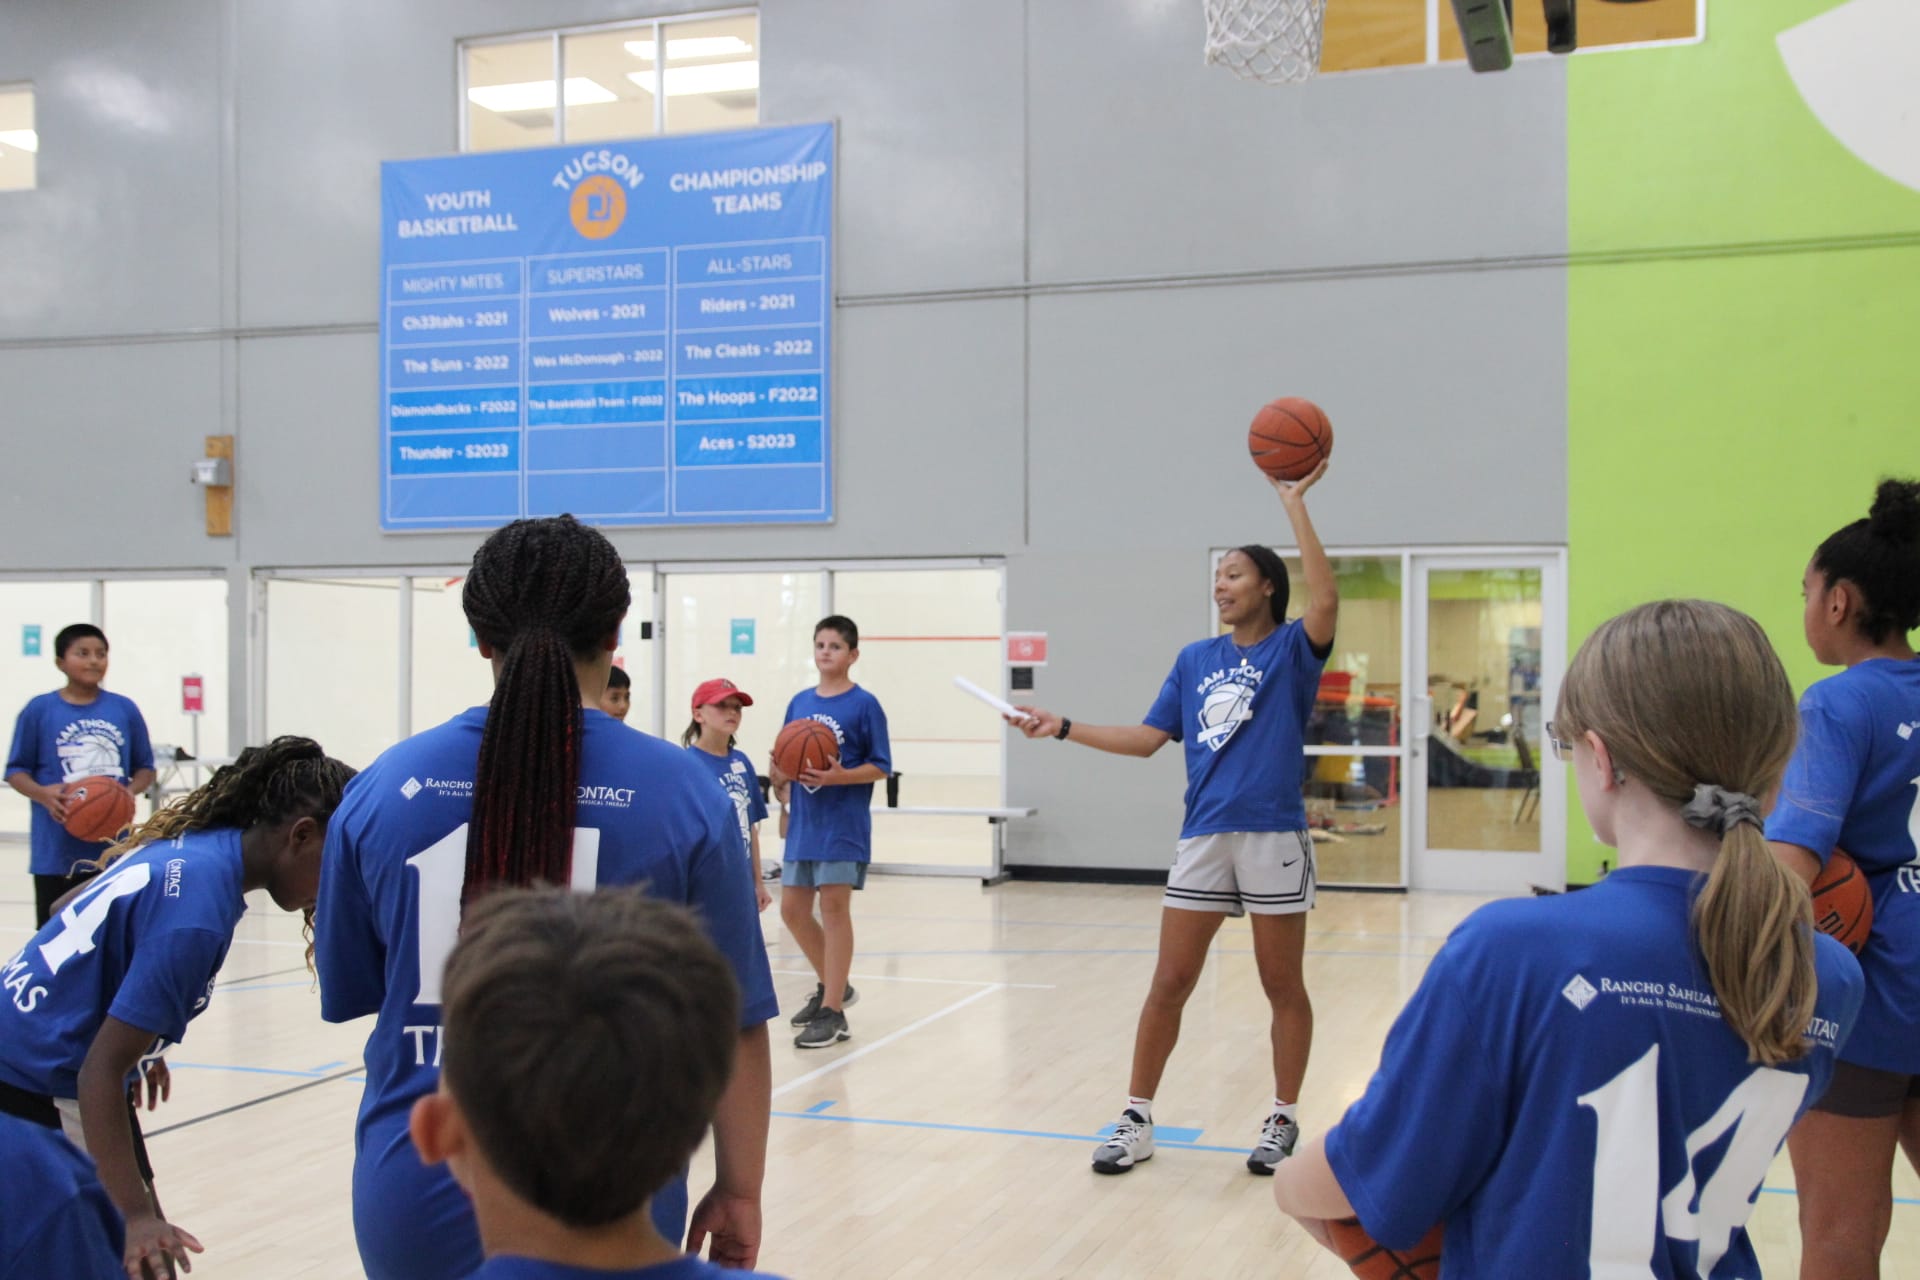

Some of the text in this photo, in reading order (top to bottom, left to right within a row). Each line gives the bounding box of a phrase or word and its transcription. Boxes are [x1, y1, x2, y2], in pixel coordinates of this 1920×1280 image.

[552, 150, 645, 190] TUCSON
[669, 161, 827, 193] CHAMPIONSHIP
[424, 189, 491, 212] YOUTH
[712, 191, 782, 215] TEAMS
[398, 212, 518, 238] BASKETBALL
[547, 263, 644, 285] SUPERSTARS
[707, 254, 792, 274] ALL-STARS
[402, 272, 504, 293] MIGHTY MITES
[549, 306, 600, 322] Wolves
[611, 303, 646, 320] 2021
[701, 297, 747, 314] Riders
[759, 294, 795, 311] 2021
[475, 311, 508, 327] 2021
[685, 344, 712, 360] The
[715, 342, 760, 358] Cleats
[773, 339, 813, 356] 2022
[403, 359, 428, 373] The
[431, 358, 463, 372] Suns
[474, 355, 509, 371] 2022
[678, 391, 705, 406] The
[707, 389, 757, 406] Hoops
[769, 386, 818, 403] F2022
[391, 402, 472, 417] Diamondbacks
[400, 445, 454, 460] Thunder
[465, 443, 509, 459] S2023
[699, 436, 735, 450] Aces
[747, 433, 796, 449] S2023
[425, 777, 473, 790] RANCHO
[576, 786, 636, 803] ONTACT
[2, 949, 49, 1016] MAS
[1600, 977, 1664, 995] RANCHO
[1621, 995, 1636, 1005] IT'S
[1638, 996, 1654, 1006] ALL
[1656, 997, 1664, 1008] IN
[1665, 999, 1684, 1011] YOUR
[1577, 1042, 1810, 1280] 14
